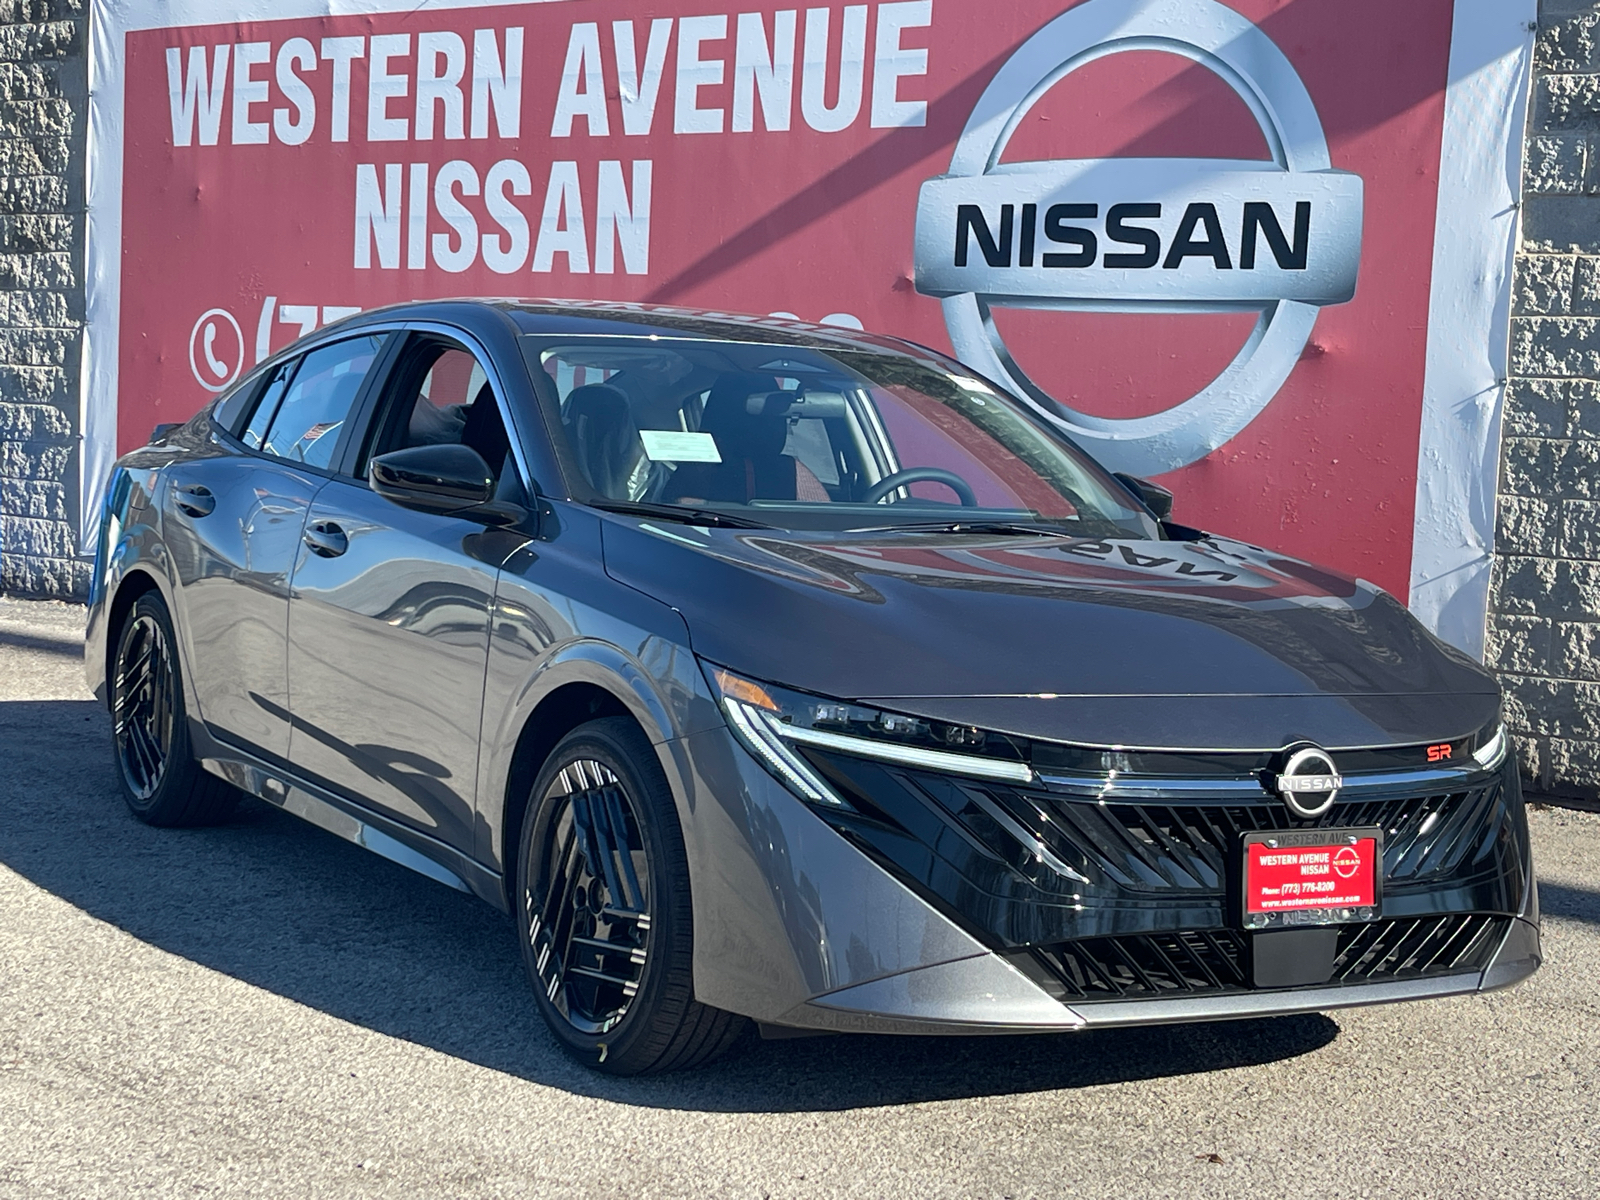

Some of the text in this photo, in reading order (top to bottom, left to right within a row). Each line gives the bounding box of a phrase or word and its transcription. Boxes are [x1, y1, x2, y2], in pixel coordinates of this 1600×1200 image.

[166, 2, 930, 147] WESTERN AVENUE
[353, 158, 653, 276] NISSAN
[954, 200, 1312, 270] NISSAN
[1427, 744, 1452, 762] SR
[1279, 777, 1342, 790] NISSAN
[1277, 834, 1325, 846] WESTERN
[1260, 853, 1330, 866] WESTERN AVENUE
[1300, 865, 1329, 875] NISSAN
[1261, 881, 1335, 896] Phone: (773) 776-8200
[1282, 908, 1343, 925] NISSAN
